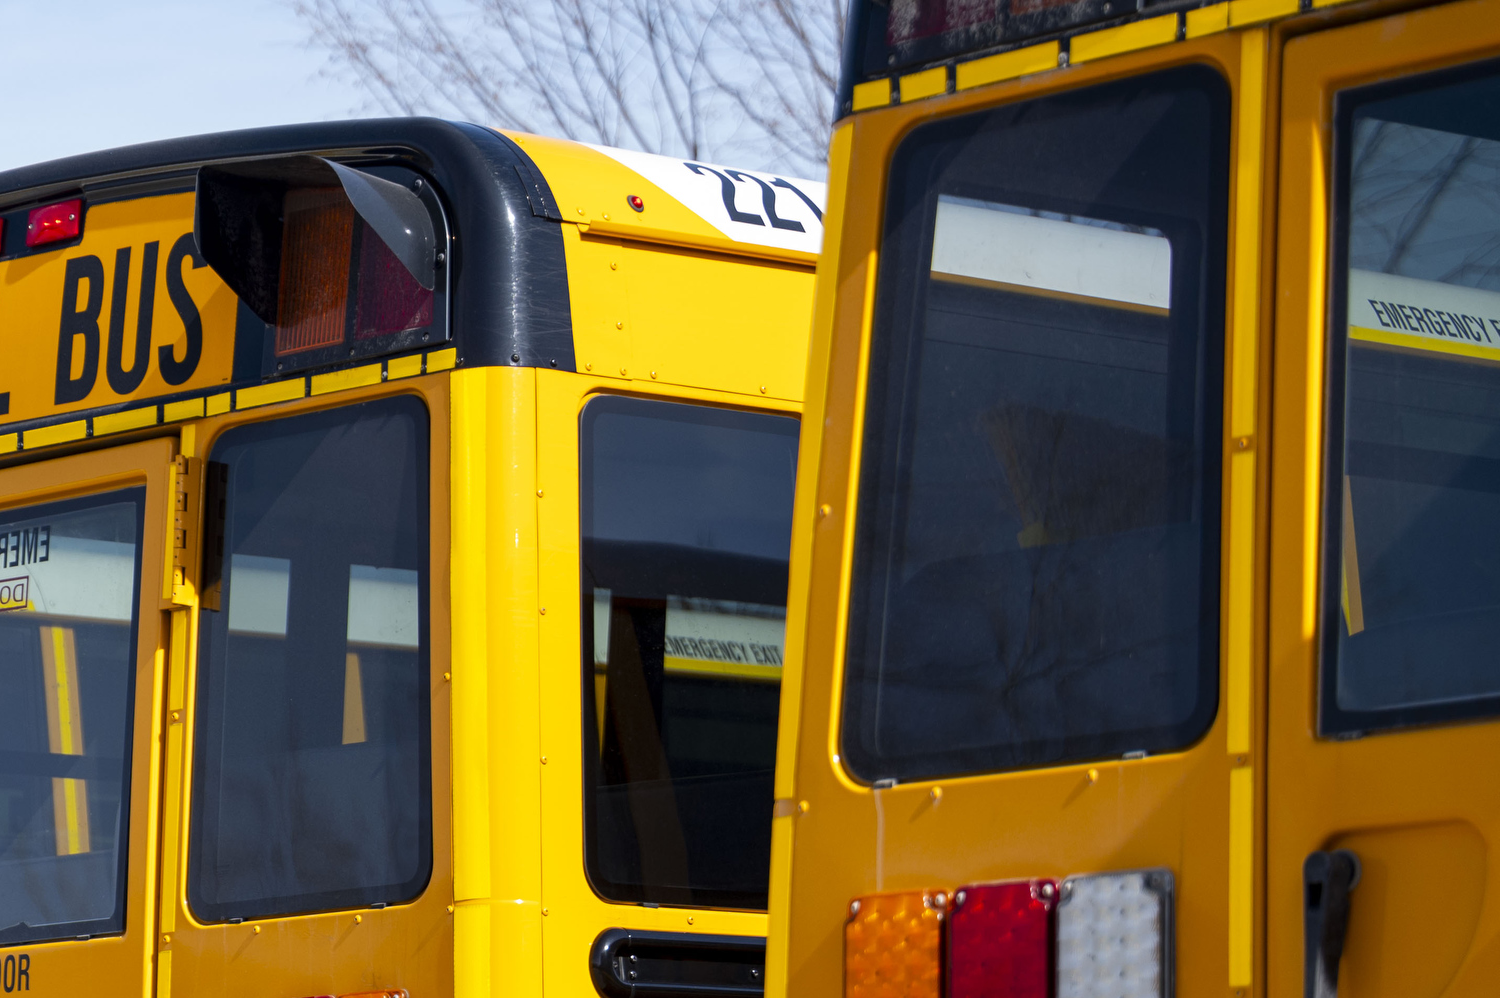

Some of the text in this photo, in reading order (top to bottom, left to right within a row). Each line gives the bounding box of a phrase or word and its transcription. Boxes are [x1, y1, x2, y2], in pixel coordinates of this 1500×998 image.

[54, 231, 208, 406] BUS
[1367, 299, 1492, 343] EMERGENCY
[749, 643, 782, 667] EXIT
